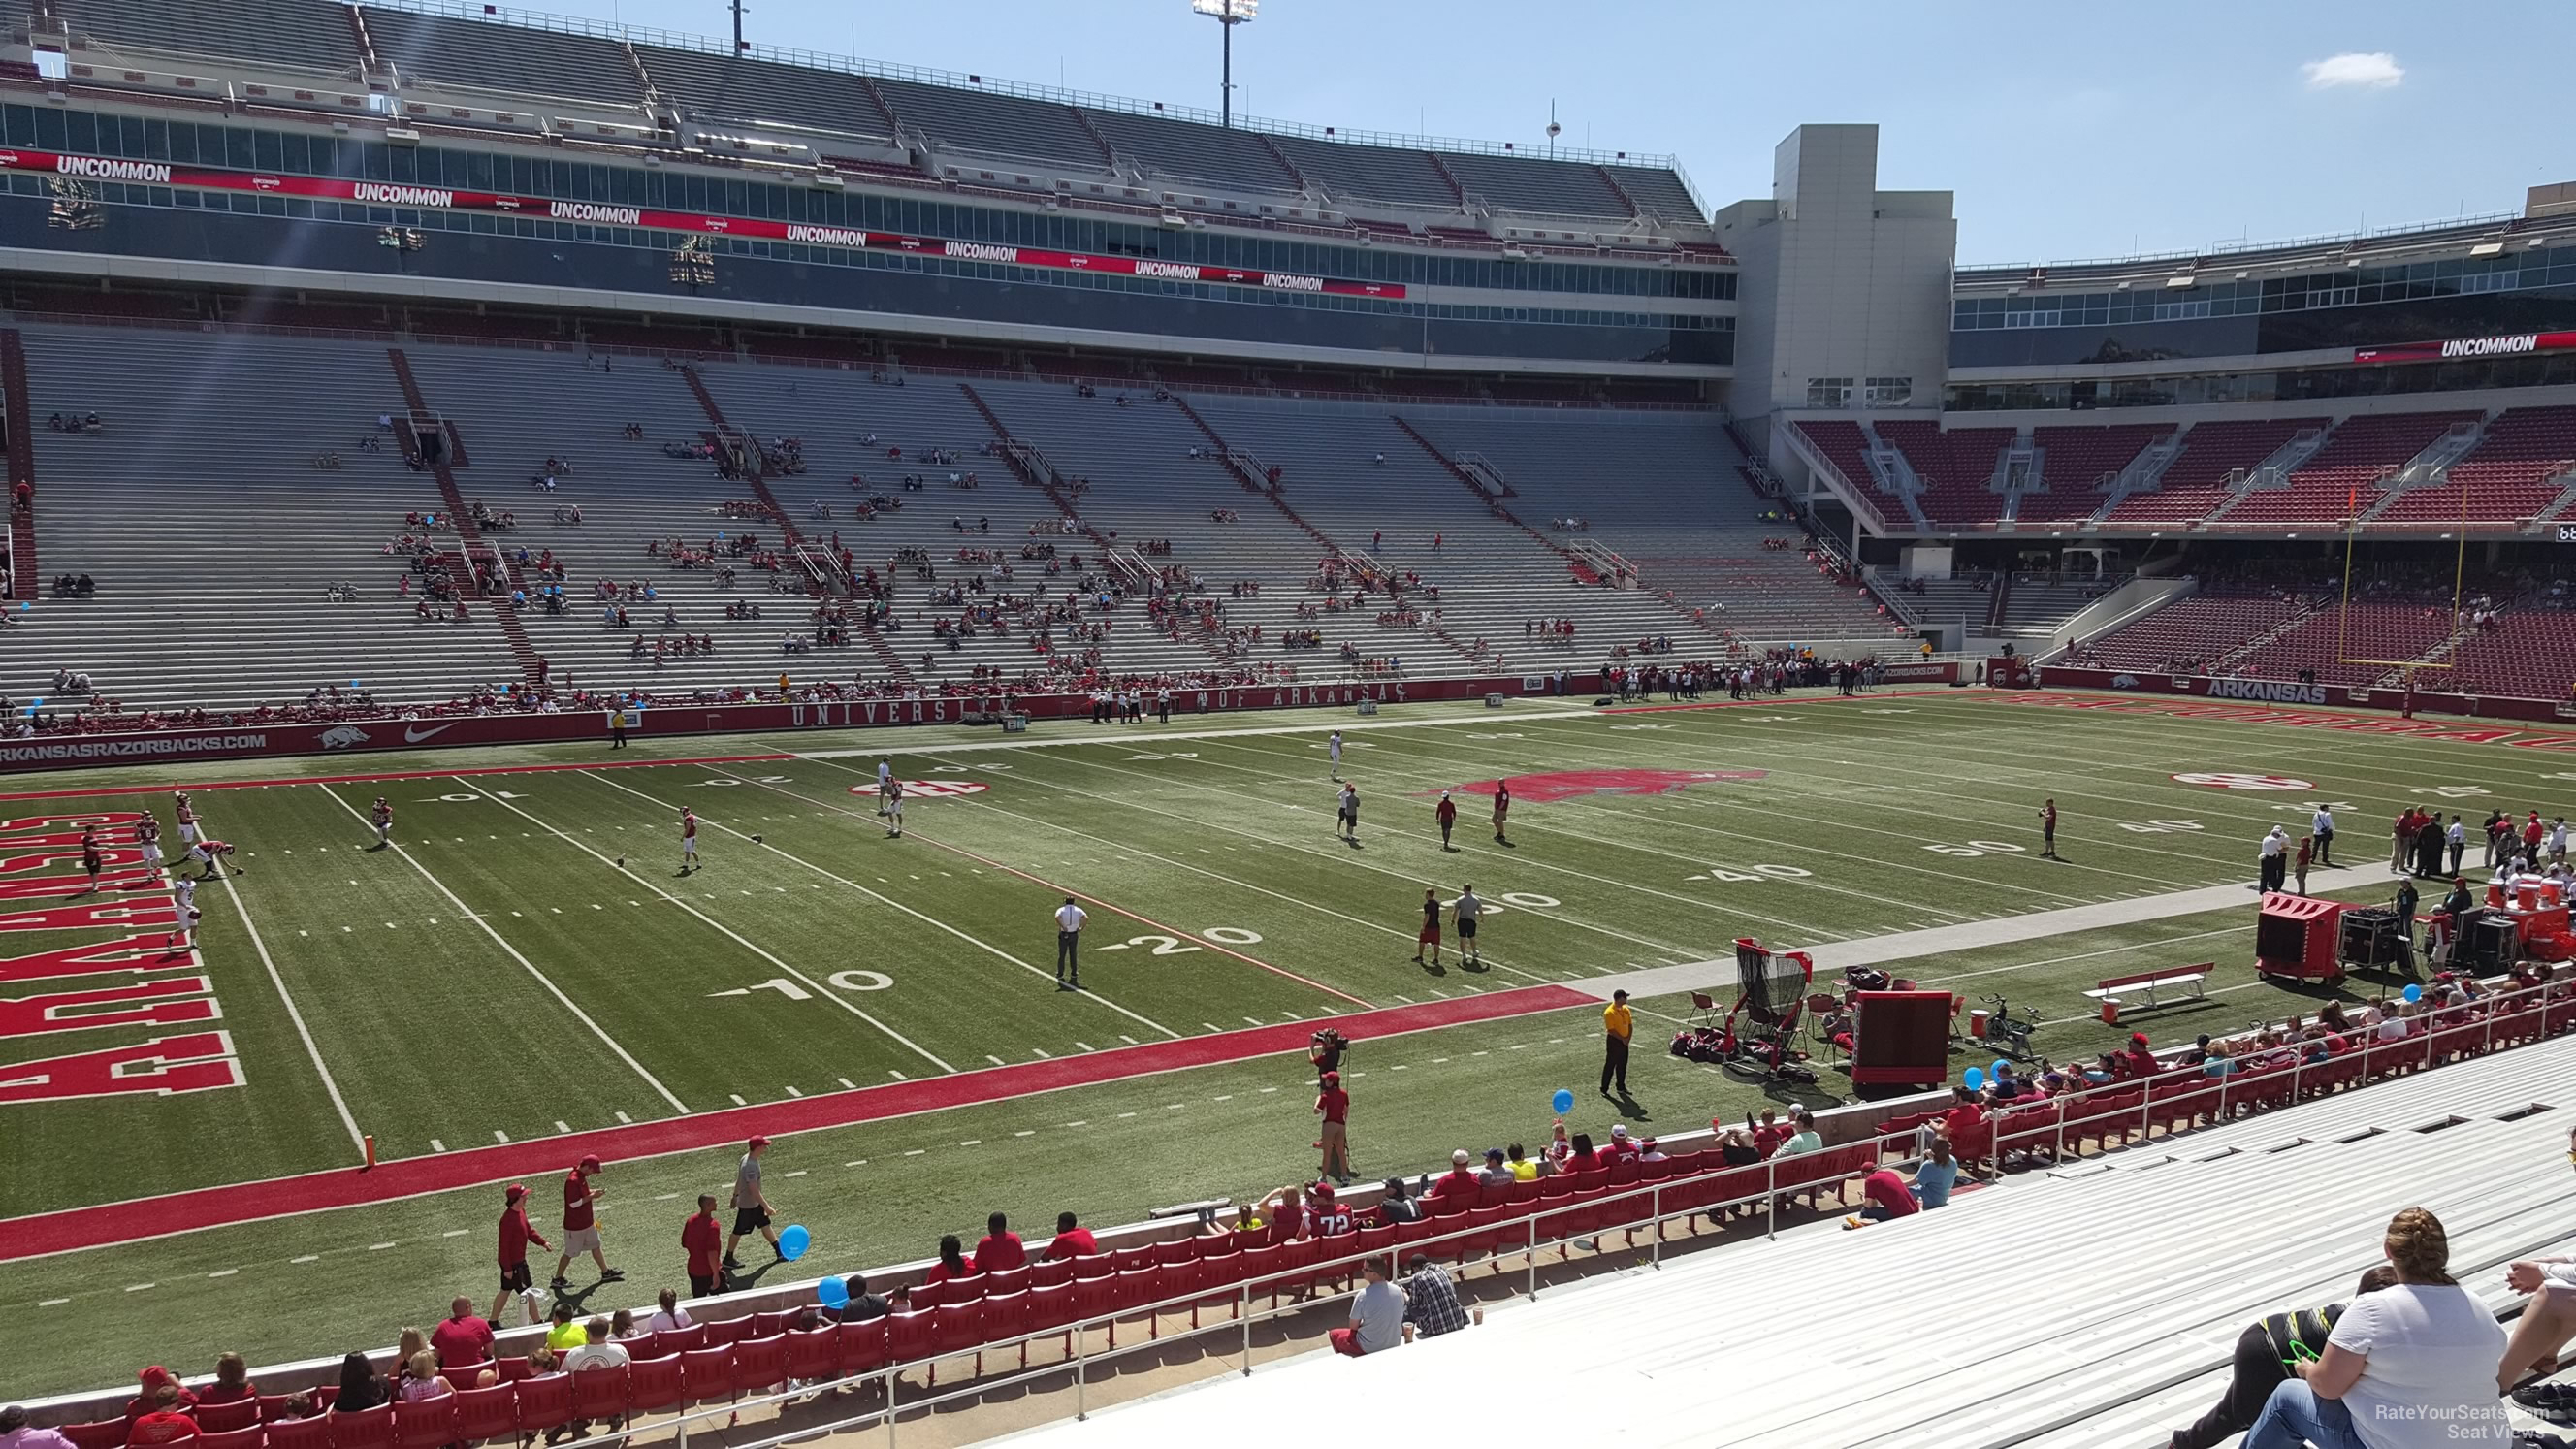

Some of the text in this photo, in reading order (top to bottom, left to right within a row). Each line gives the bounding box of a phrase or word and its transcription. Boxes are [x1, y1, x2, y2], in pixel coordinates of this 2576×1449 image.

[57, 155, 171, 182] UNCOMMON
[354, 182, 452, 208] UNCOMMON
[551, 201, 640, 224] UNCOMMON
[787, 225, 866, 246] UNCOMMON
[945, 242, 1017, 262] UNCOMMON
[1135, 261, 1200, 279] UNCOMMON
[1263, 273, 1323, 291] UNCOMMON
[2441, 335, 2537, 357] UNCOMMON
[2206, 679, 2326, 704] ARKANSAS
[1921, 840, 2026, 856] 50
[1711, 864, 1812, 882] 40
[1127, 927, 1263, 955] 20
[750, 970, 893, 1000] 10
[1320, 1215, 1349, 1236] 72
